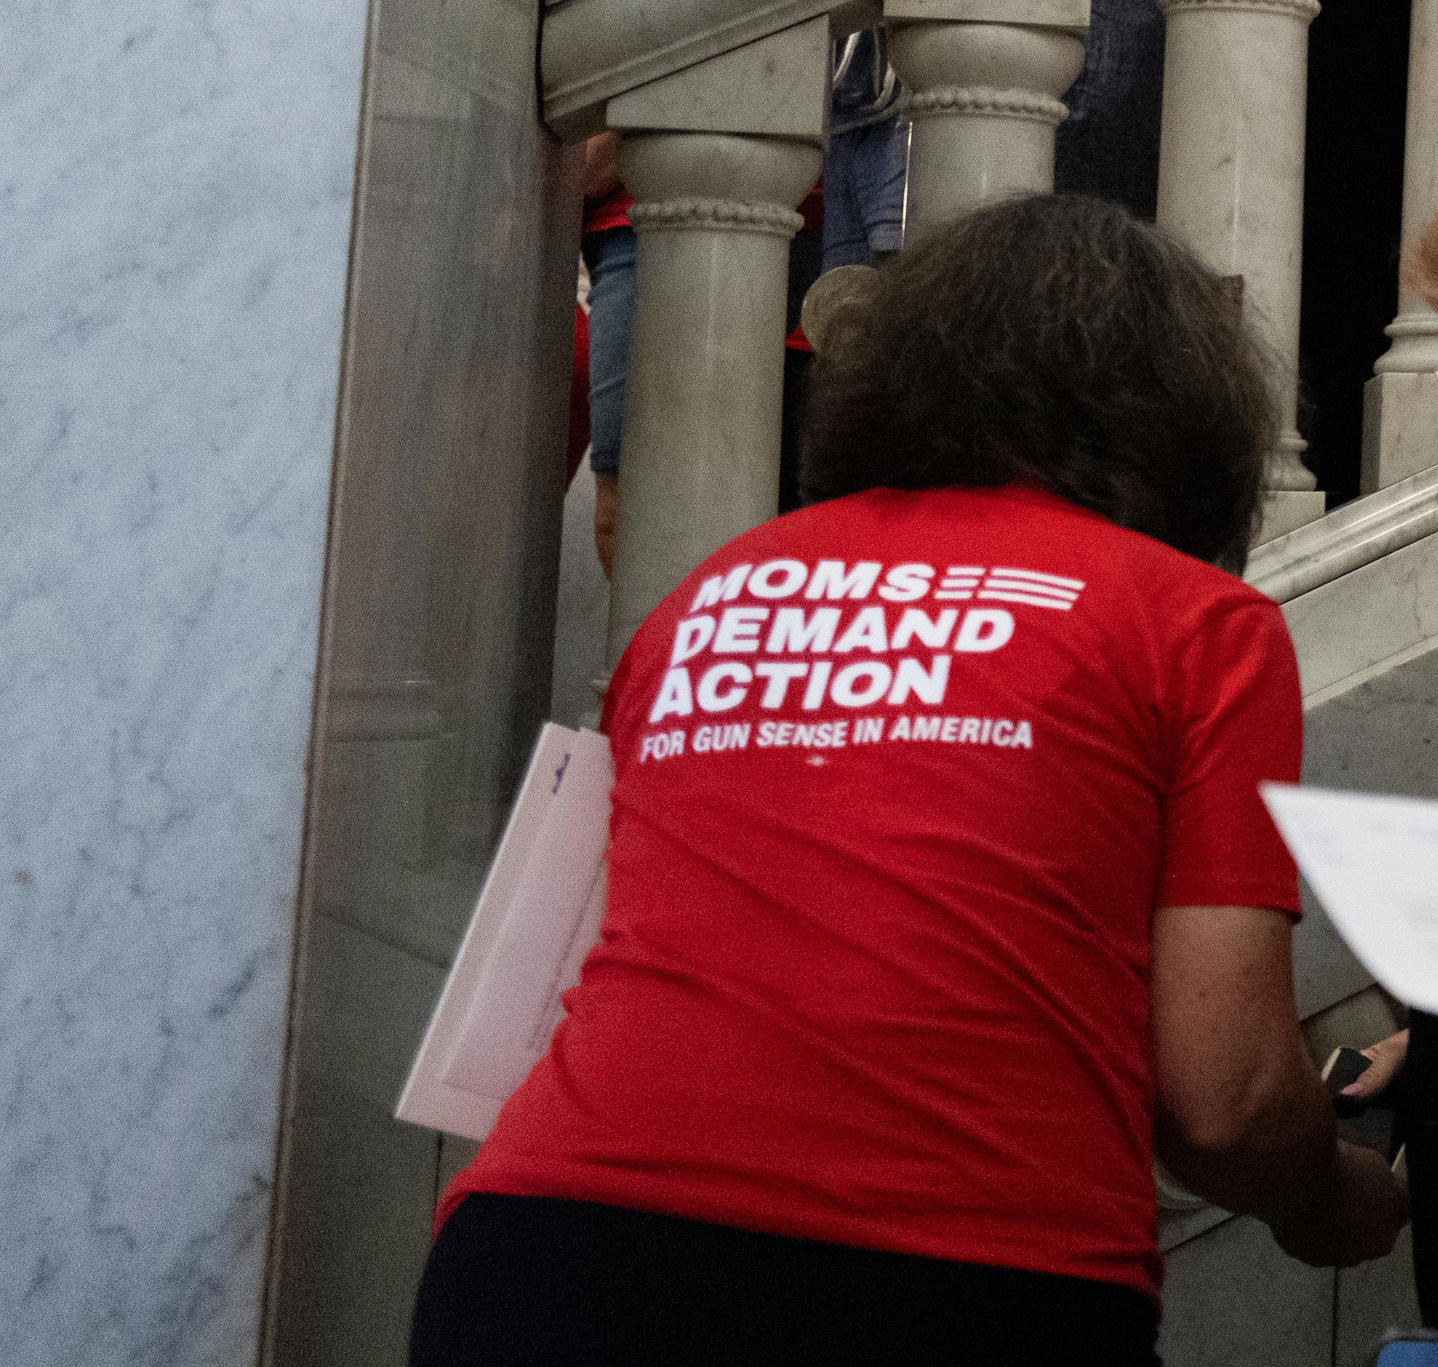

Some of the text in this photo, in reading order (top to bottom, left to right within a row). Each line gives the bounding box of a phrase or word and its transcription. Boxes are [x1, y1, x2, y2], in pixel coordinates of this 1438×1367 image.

[689, 558, 936, 613] MOMS
[668, 605, 1015, 667] DEMAND
[648, 654, 952, 724] ACTION
[638, 716, 1034, 764] FOR GUN SENSE IN AMERICA
